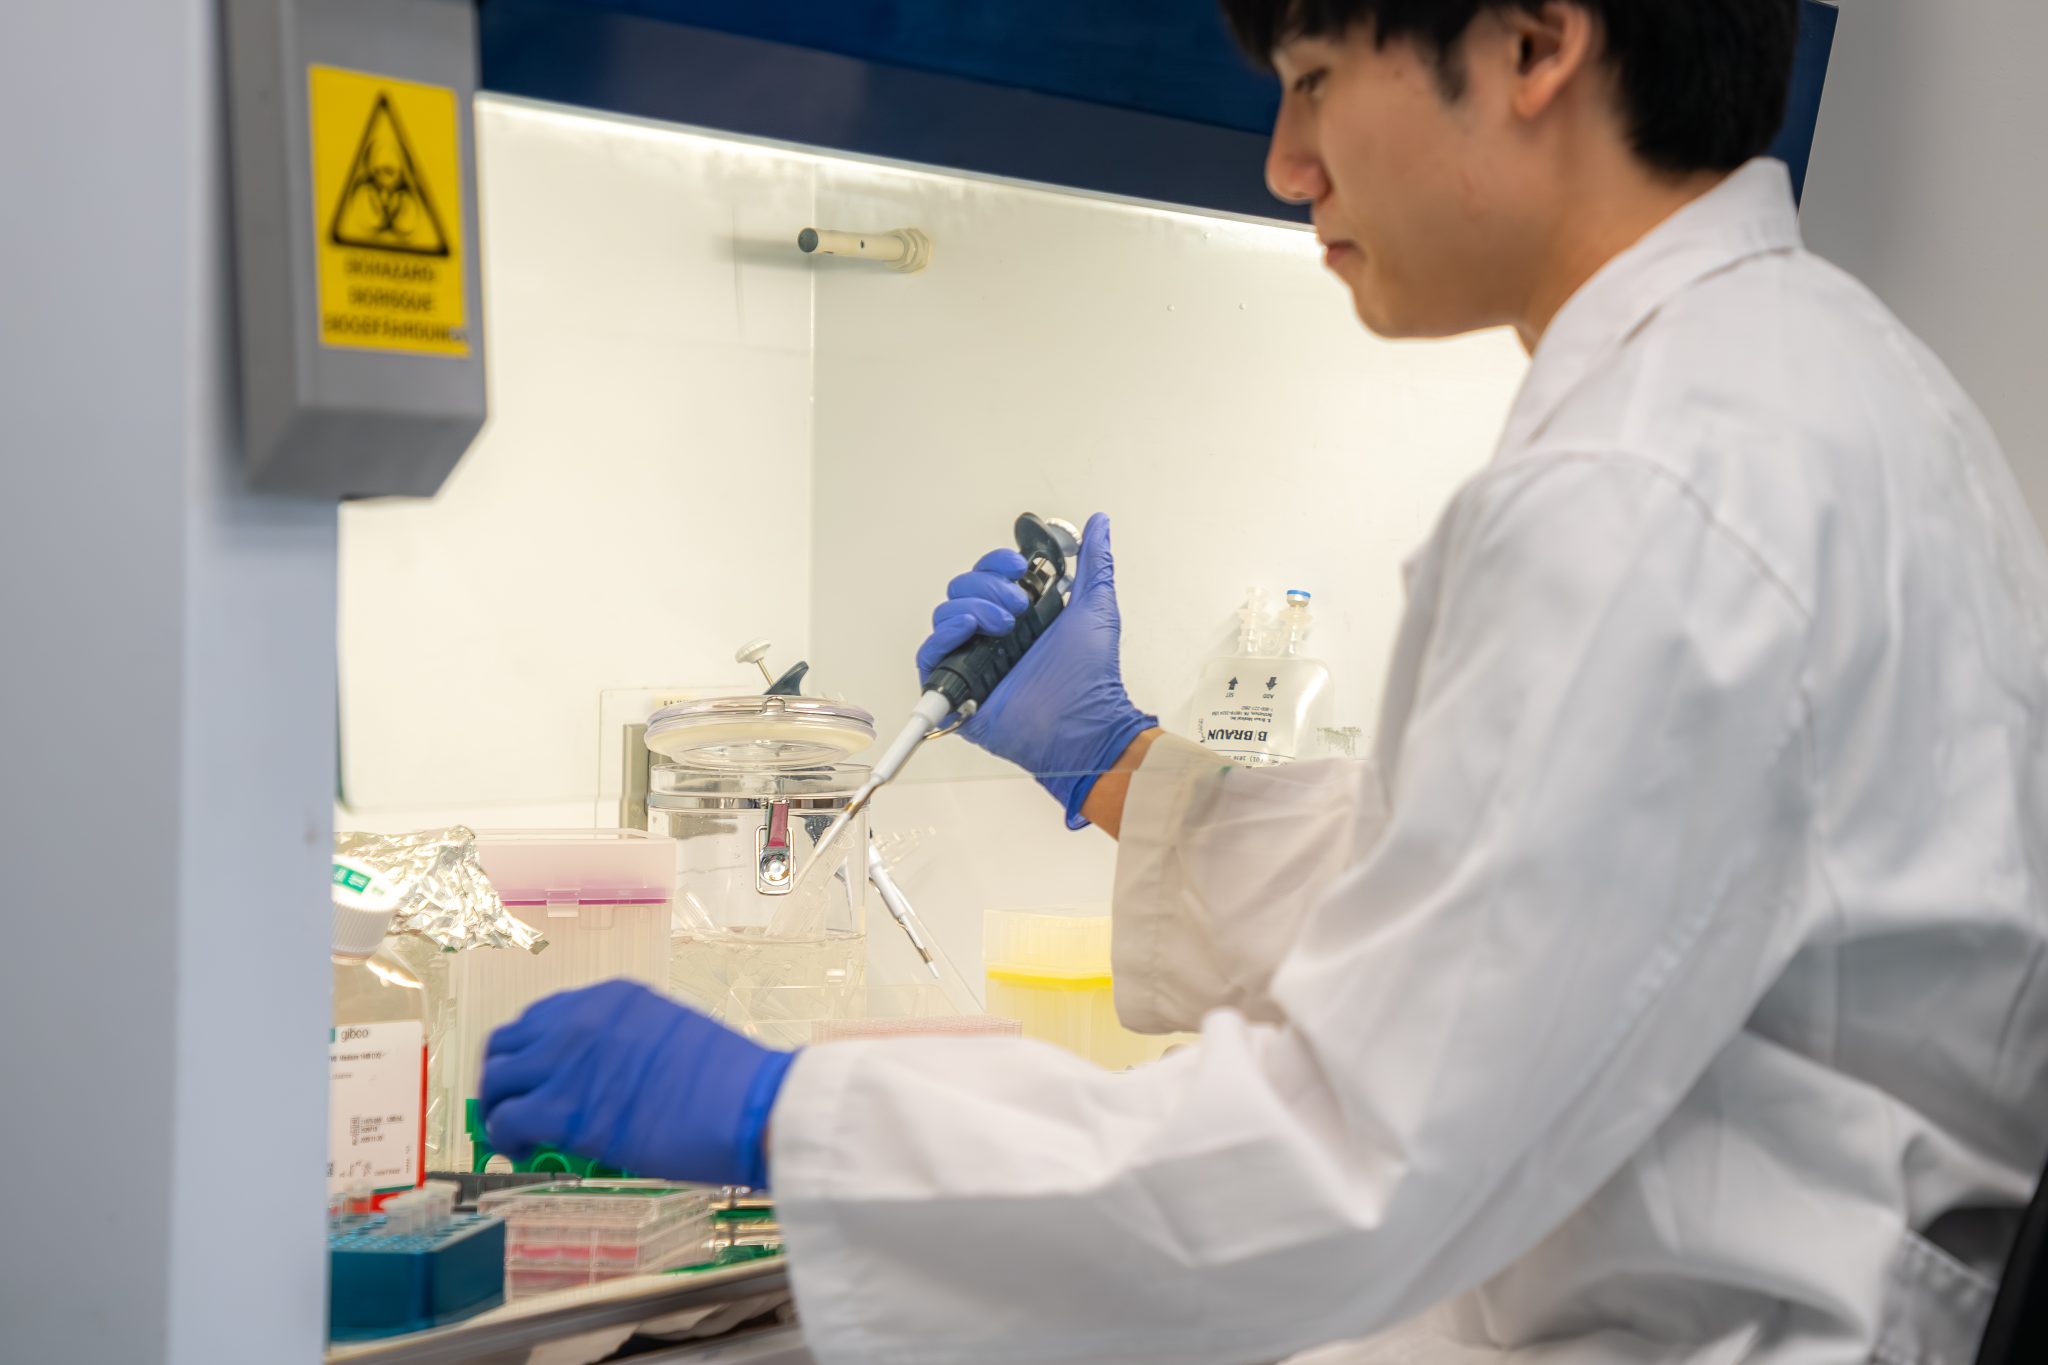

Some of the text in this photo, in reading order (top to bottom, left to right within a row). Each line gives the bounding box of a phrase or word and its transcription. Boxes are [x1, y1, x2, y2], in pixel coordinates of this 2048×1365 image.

[346, 258, 436, 281] BIOHAZARD
[1207, 729, 1254, 741] BRAUN
[341, 1028, 369, 1043] gibco
